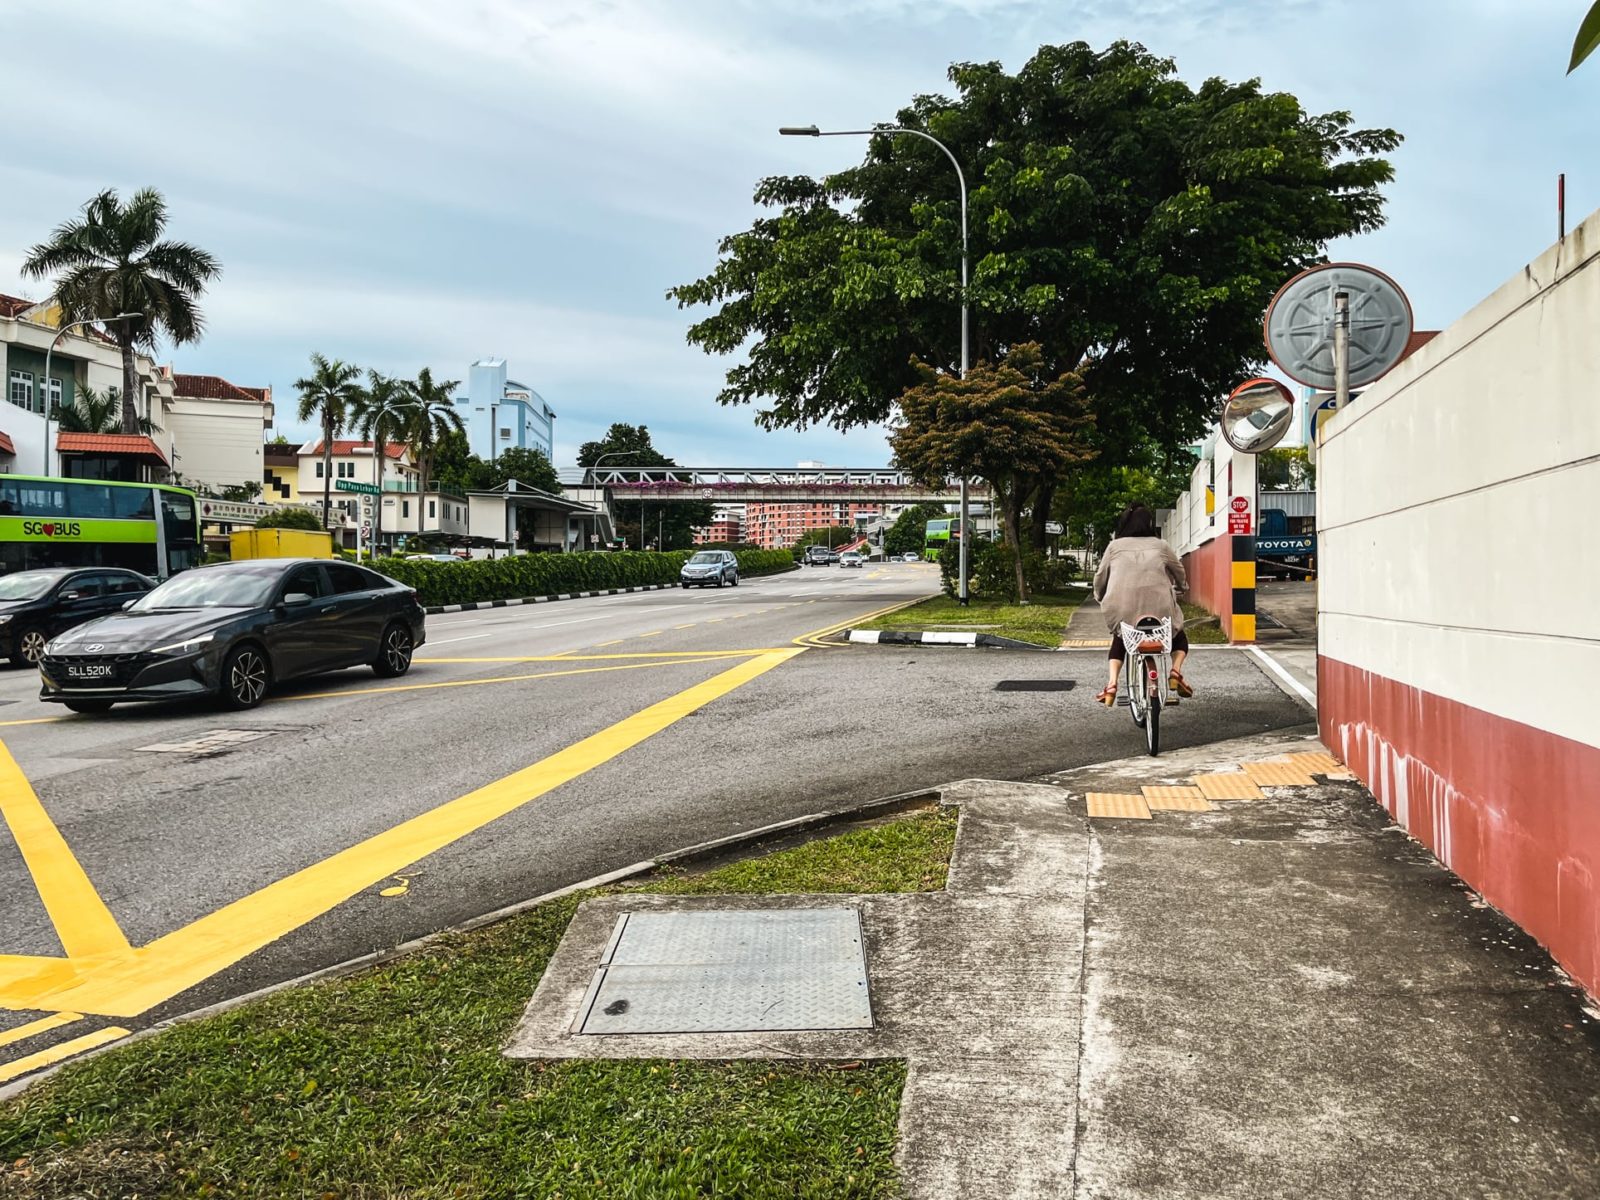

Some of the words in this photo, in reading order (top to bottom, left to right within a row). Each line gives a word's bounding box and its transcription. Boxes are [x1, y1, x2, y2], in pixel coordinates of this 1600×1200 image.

[347, 482, 359, 491] Paya
[1232, 501, 1247, 509] STOP
[1256, 540, 1304, 549] TOYOTA
[68, 665, 112, 676] SLL520K
